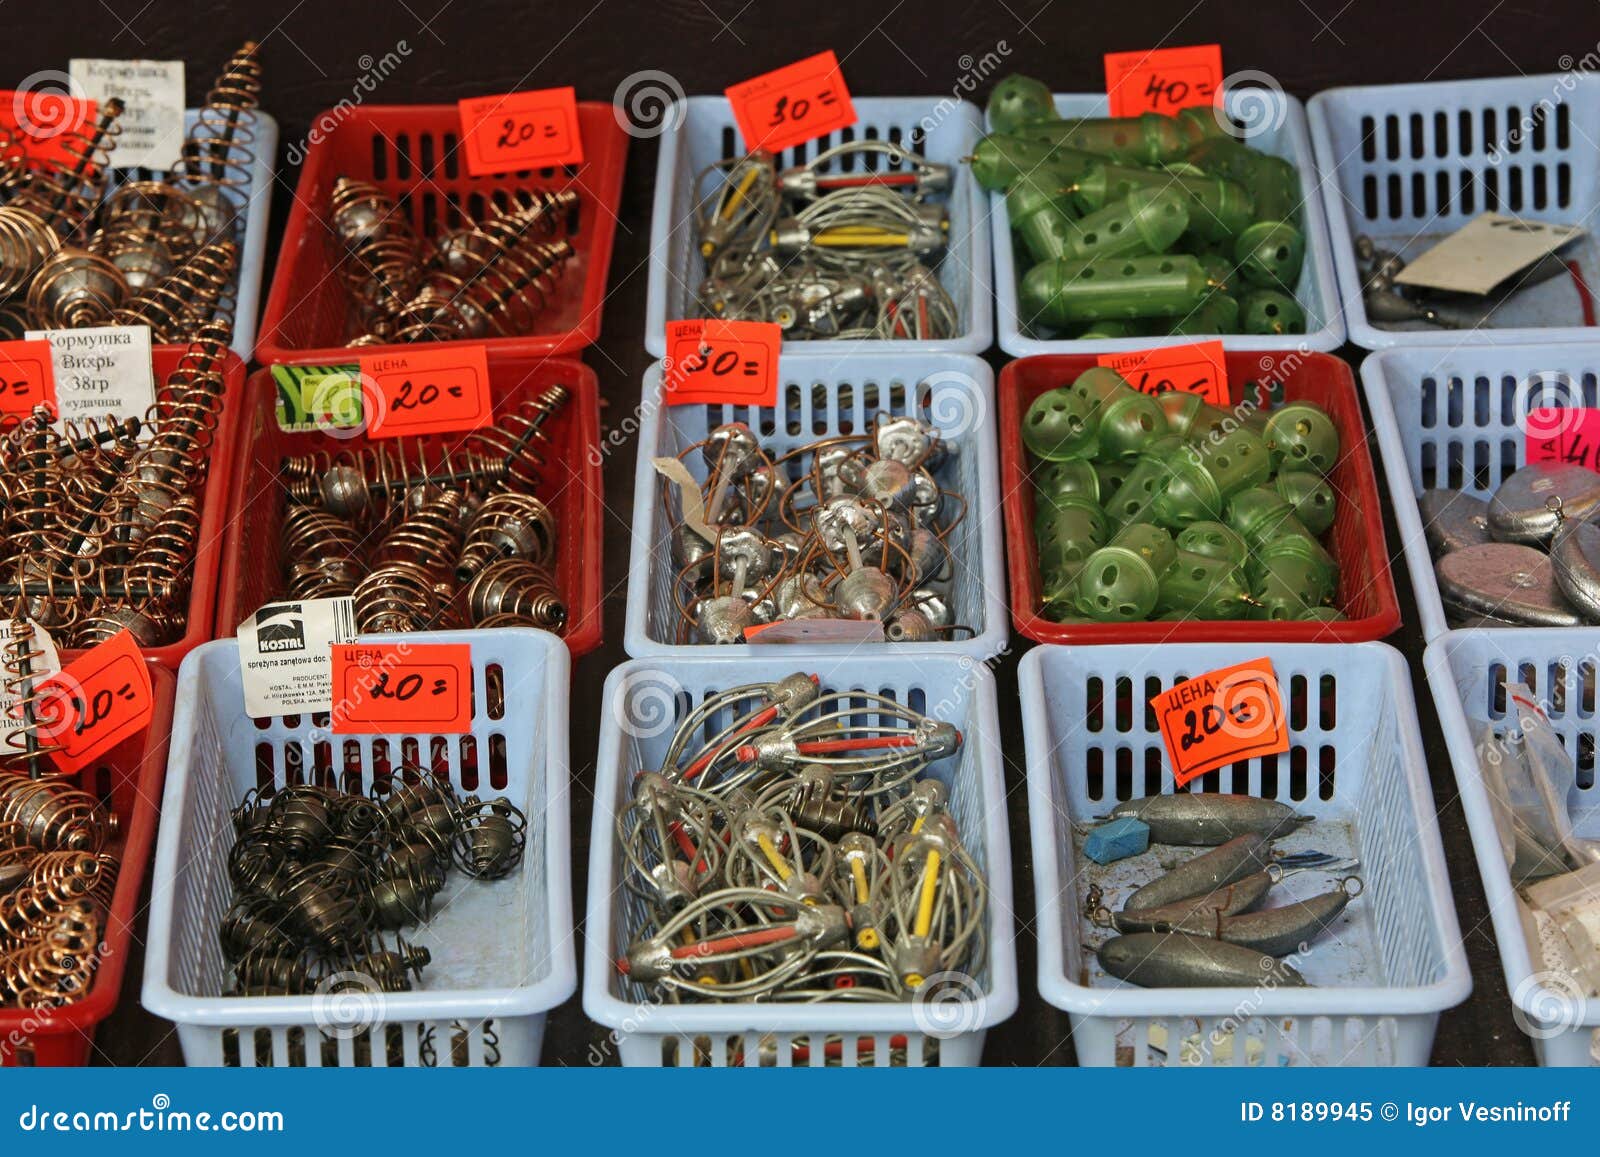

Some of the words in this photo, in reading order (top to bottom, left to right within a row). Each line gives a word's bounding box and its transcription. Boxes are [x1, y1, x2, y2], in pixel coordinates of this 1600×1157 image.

[675, 325, 702, 337] ЦЕНА
[62, 354, 115, 372] Вихрь
[374, 360, 408, 372] ЦЕНА
[72, 376, 109, 393] 38гр
[259, 638, 304, 652] KOSTAL
[344, 650, 383, 662] ЦЕНА
